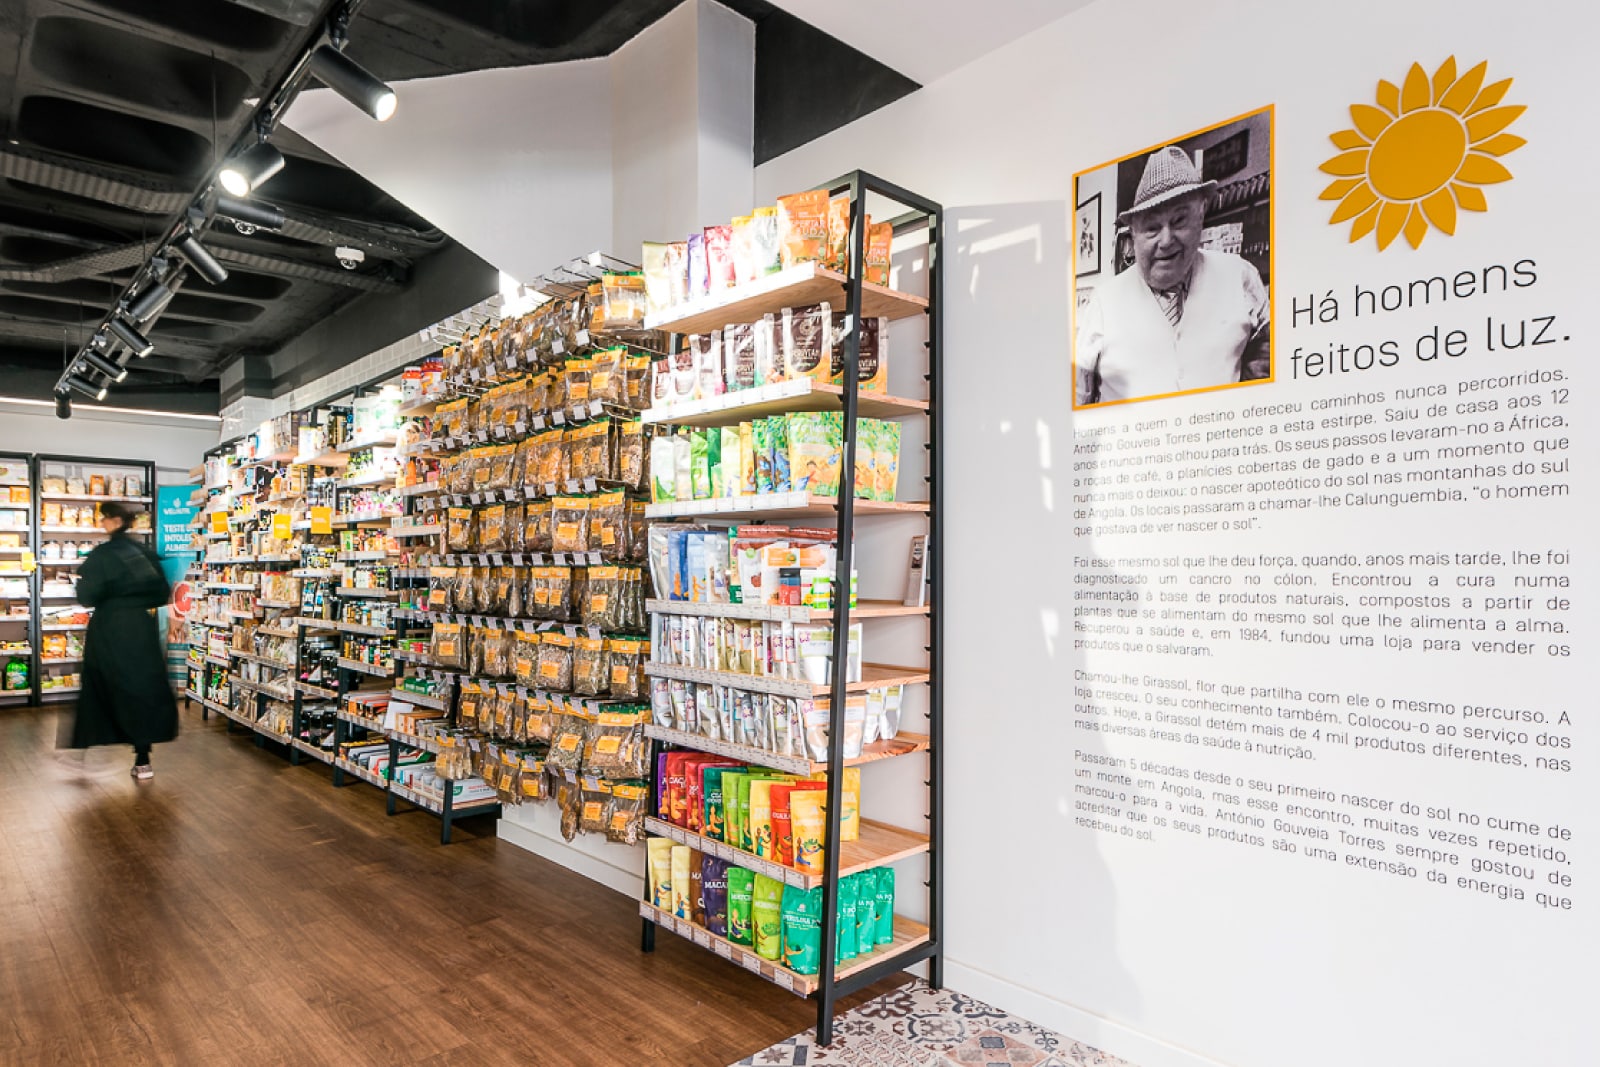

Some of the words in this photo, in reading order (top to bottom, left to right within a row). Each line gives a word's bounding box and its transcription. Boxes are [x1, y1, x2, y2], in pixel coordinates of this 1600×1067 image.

[1292, 290, 1338, 328] Há
[1355, 259, 1537, 316] homens
[1290, 341, 1400, 380] feitos
[1416, 326, 1467, 361] de
[1487, 315, 1570, 351] luz.
[1242, 402, 1302, 418] ofereceu
[1310, 391, 1386, 410] caminhos
[1395, 384, 1447, 400] nunca
[1458, 369, 1568, 395] percorridos.
[1073, 442, 1113, 454] António
[1165, 432, 1201, 445] Torres
[1206, 425, 1263, 442] pertence
[1283, 420, 1314, 432] esta
[1320, 414, 1376, 428] estirpe.
[1384, 408, 1418, 422] Saiu
[1427, 403, 1447, 417] de
[1455, 400, 1498, 414] casa
[1507, 394, 1542, 409] aos
[1551, 388, 1569, 404] 12
[1211, 447, 1239, 460] para
[1242, 442, 1270, 455] trás.
[1275, 440, 1292, 453] Os
[1295, 438, 1329, 451] seus
[1332, 432, 1387, 449] passos
[1391, 423, 1489, 441] levaram-no
[1508, 414, 1568, 431] África,
[1237, 460, 1296, 474] cobertas
[1302, 457, 1320, 469] de
[1326, 453, 1364, 470] gado
[1403, 448, 1429, 461] um
[1437, 441, 1524, 458] momento
[1533, 437, 1569, 454] que
[1200, 483, 1242, 495] nascer
[1246, 477, 1320, 494] apoteótico
[1324, 474, 1342, 487] do
[1346, 472, 1368, 486] sol
[1374, 472, 1402, 484] nas
[1406, 464, 1507, 481] montanhas
[1512, 461, 1535, 475] do
[1541, 458, 1568, 474] sul
[1259, 495, 1341, 510] chamar-lhe
[1345, 488, 1467, 507] Calunguembia,
[1496, 484, 1569, 498] homem
[1073, 526, 1093, 538] que
[1073, 556, 1089, 568] Foi
[1208, 554, 1228, 567] lhe
[1230, 554, 1255, 567] deu
[1259, 554, 1297, 568] força,
[1301, 554, 1361, 568] quando,
[1365, 554, 1404, 566] anos
[1409, 552, 1450, 565] mais
[1455, 551, 1506, 566] tarde,
[1512, 550, 1540, 564] lhe
[1547, 549, 1569, 564] foi
[1073, 573, 1148, 586] diagnosticado
[1244, 575, 1261, 585] no
[1273, 573, 1317, 586] cólon.
[1332, 572, 1411, 586] Encontrou
[1456, 576, 1495, 587] cura
[1514, 576, 1569, 587] numa
[1073, 589, 1139, 602] alimentação
[1218, 592, 1277, 604] produtos
[1286, 592, 1348, 606] naturais,
[1358, 596, 1450, 608] compostos
[1484, 596, 1532, 611] partir
[1546, 596, 1570, 610] de
[1074, 605, 1112, 617] plantas
[1232, 610, 1248, 622] do
[1254, 612, 1306, 624] mesmo
[1312, 612, 1334, 625] sol
[1341, 615, 1370, 628] que
[1378, 613, 1402, 628] lhe
[1410, 615, 1486, 630] alimenta
[1515, 618, 1569, 633] alma.
[1074, 621, 1130, 635] Recuperou
[1210, 629, 1231, 640] em
[1280, 630, 1330, 644] fundou
[1339, 635, 1374, 647] uma
[1384, 634, 1412, 651] loja
[1423, 639, 1460, 652] para
[1471, 640, 1535, 654] vender
[1547, 644, 1570, 656] os
[1220, 684, 1245, 696] que
[1250, 686, 1302, 700] partilha
[1308, 692, 1340, 704] com
[1346, 693, 1370, 707] ele
[1392, 699, 1455, 714] mesmo
[1463, 705, 1549, 723] percurso.
[1558, 710, 1571, 725] A
[1202, 736, 1240, 750] saúde
[1244, 739, 1252, 752] à
[1256, 743, 1316, 760] nutrição.
[1206, 717, 1247, 732] detém
[1251, 724, 1284, 737] mais
[1289, 726, 1306, 740] de
[1312, 729, 1320, 741] 4
[1326, 732, 1348, 745] mil
[1355, 736, 1426, 754] produtos
[1432, 743, 1527, 767] diferentes,
[1536, 757, 1571, 771] nas
[1277, 707, 1342, 724] também.
[1348, 712, 1429, 733] Colocou-o
[1435, 723, 1457, 736] ao
[1463, 726, 1528, 744] serviço
[1535, 732, 1571, 748] dos
[1074, 750, 1126, 767] Passaram
[1248, 779, 1272, 792] seu
[1277, 784, 1335, 802] primeiro
[1341, 794, 1394, 811] nascer
[1400, 801, 1420, 816] do
[1426, 807, 1450, 821] sol
[1458, 812, 1480, 825] no
[1487, 817, 1540, 835] cume
[1547, 824, 1571, 840] de
[1074, 784, 1126, 802] marcou-o
[1215, 808, 1265, 828] António
[1273, 818, 1328, 840] Gouveia
[1338, 830, 1386, 851] Torres
[1395, 844, 1459, 865] sempre
[1471, 858, 1534, 880] gostou
[1547, 870, 1572, 886] de
[1212, 791, 1240, 805] mas
[1246, 798, 1278, 812] esse
[1286, 804, 1354, 826] encontro,
[1363, 818, 1419, 837] muitas
[1428, 829, 1478, 847] vezes
[1488, 839, 1570, 865] repetido,
[1074, 800, 1120, 816] acreditar
[1207, 827, 1265, 847] produtos
[1272, 838, 1296, 853] são
[1304, 847, 1336, 861] uma
[1345, 854, 1417, 878] extensão
[1426, 869, 1447, 884] da
[1457, 877, 1524, 900] energia
[1535, 892, 1572, 910] que
